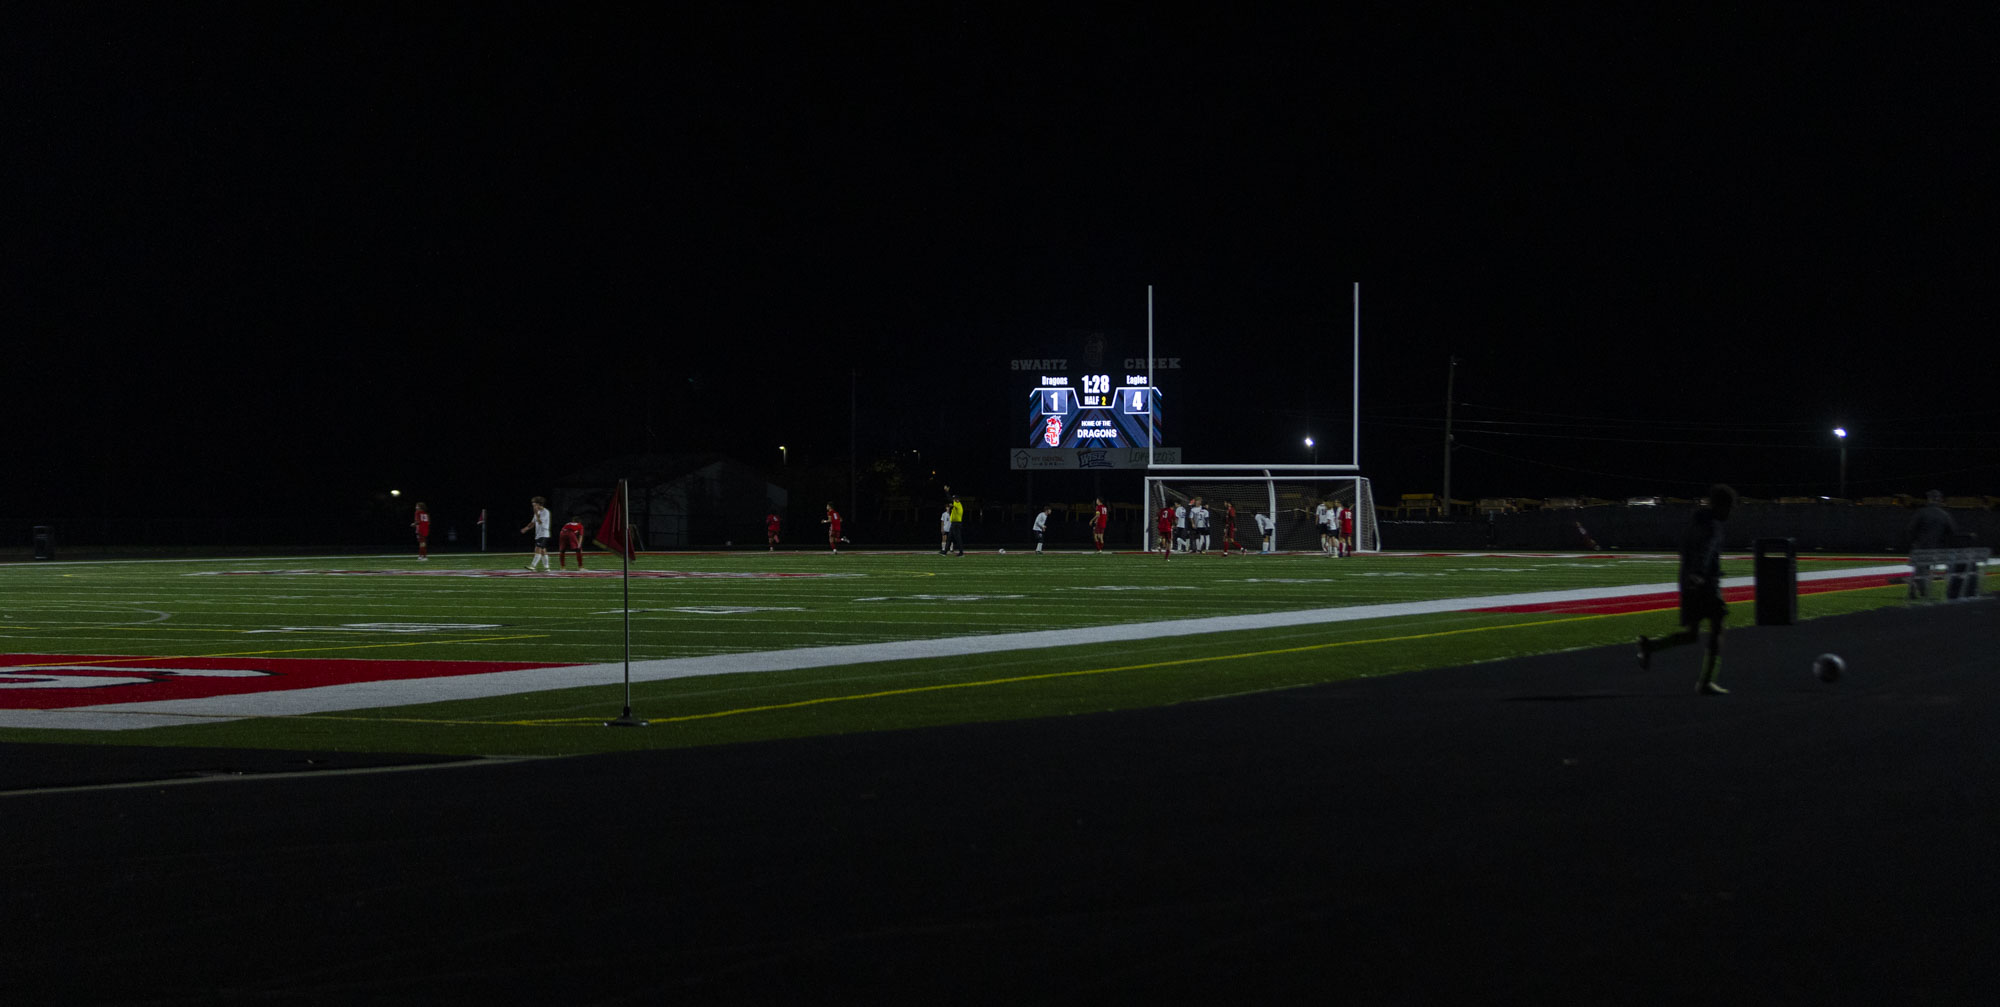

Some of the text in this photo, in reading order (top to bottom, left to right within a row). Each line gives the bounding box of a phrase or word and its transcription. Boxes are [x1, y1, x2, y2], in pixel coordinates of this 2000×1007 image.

[1010, 359, 1068, 370] SWARTZ
[1041, 376, 1068, 386] Dragons
[1081, 374, 1110, 394] 1:28
[1126, 375, 1148, 385] Eagles
[1050, 392, 1058, 411] 1
[1084, 396, 1107, 405] HALF 2
[1132, 391, 1143, 410] 4
[1077, 429, 1118, 438] DRAGONS
